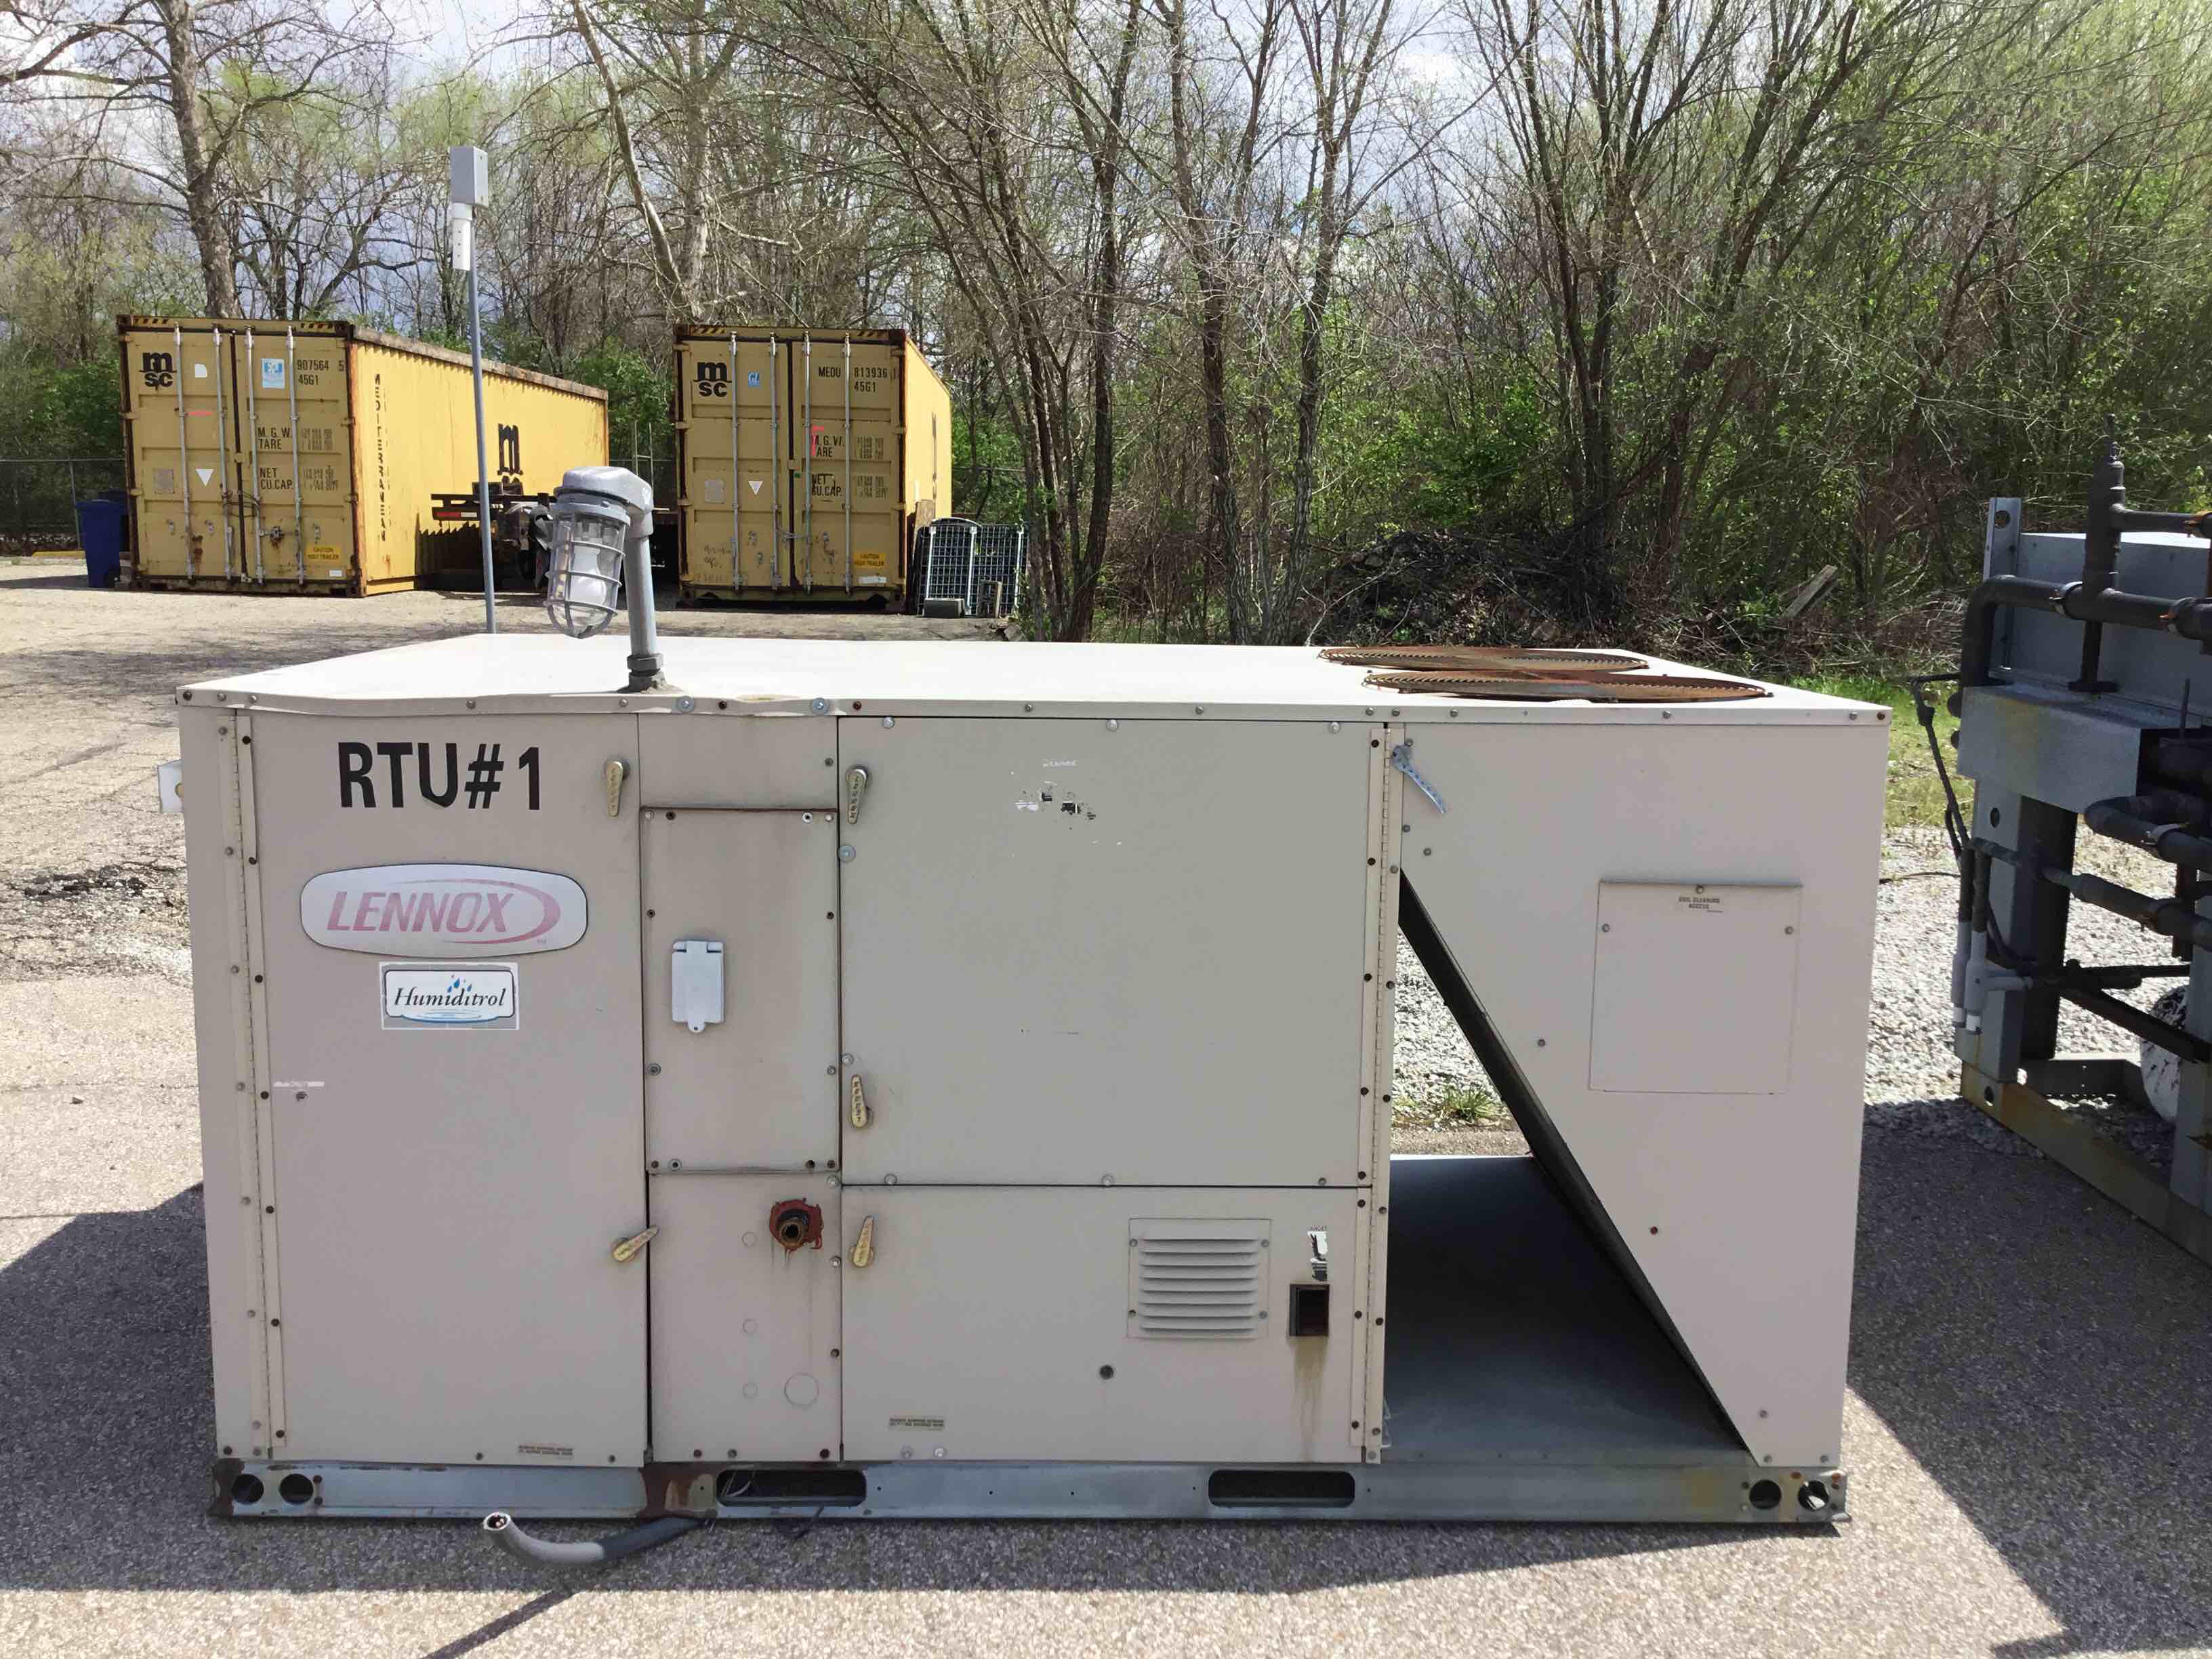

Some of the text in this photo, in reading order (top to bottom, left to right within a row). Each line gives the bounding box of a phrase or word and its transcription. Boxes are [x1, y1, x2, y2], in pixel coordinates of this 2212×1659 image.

[818, 367, 841, 377] MEDU
[854, 367, 888, 378] 813936
[854, 380, 876, 392] 45G1
[258, 439, 282, 450] TARE
[374, 373, 388, 541] MEDITERRANEAN
[815, 447, 834, 457] ARE
[260, 468, 277, 478] NET
[812, 474, 827, 485] NET
[327, 891, 514, 933] LENNOX
[394, 986, 506, 1006] Humiditrol
